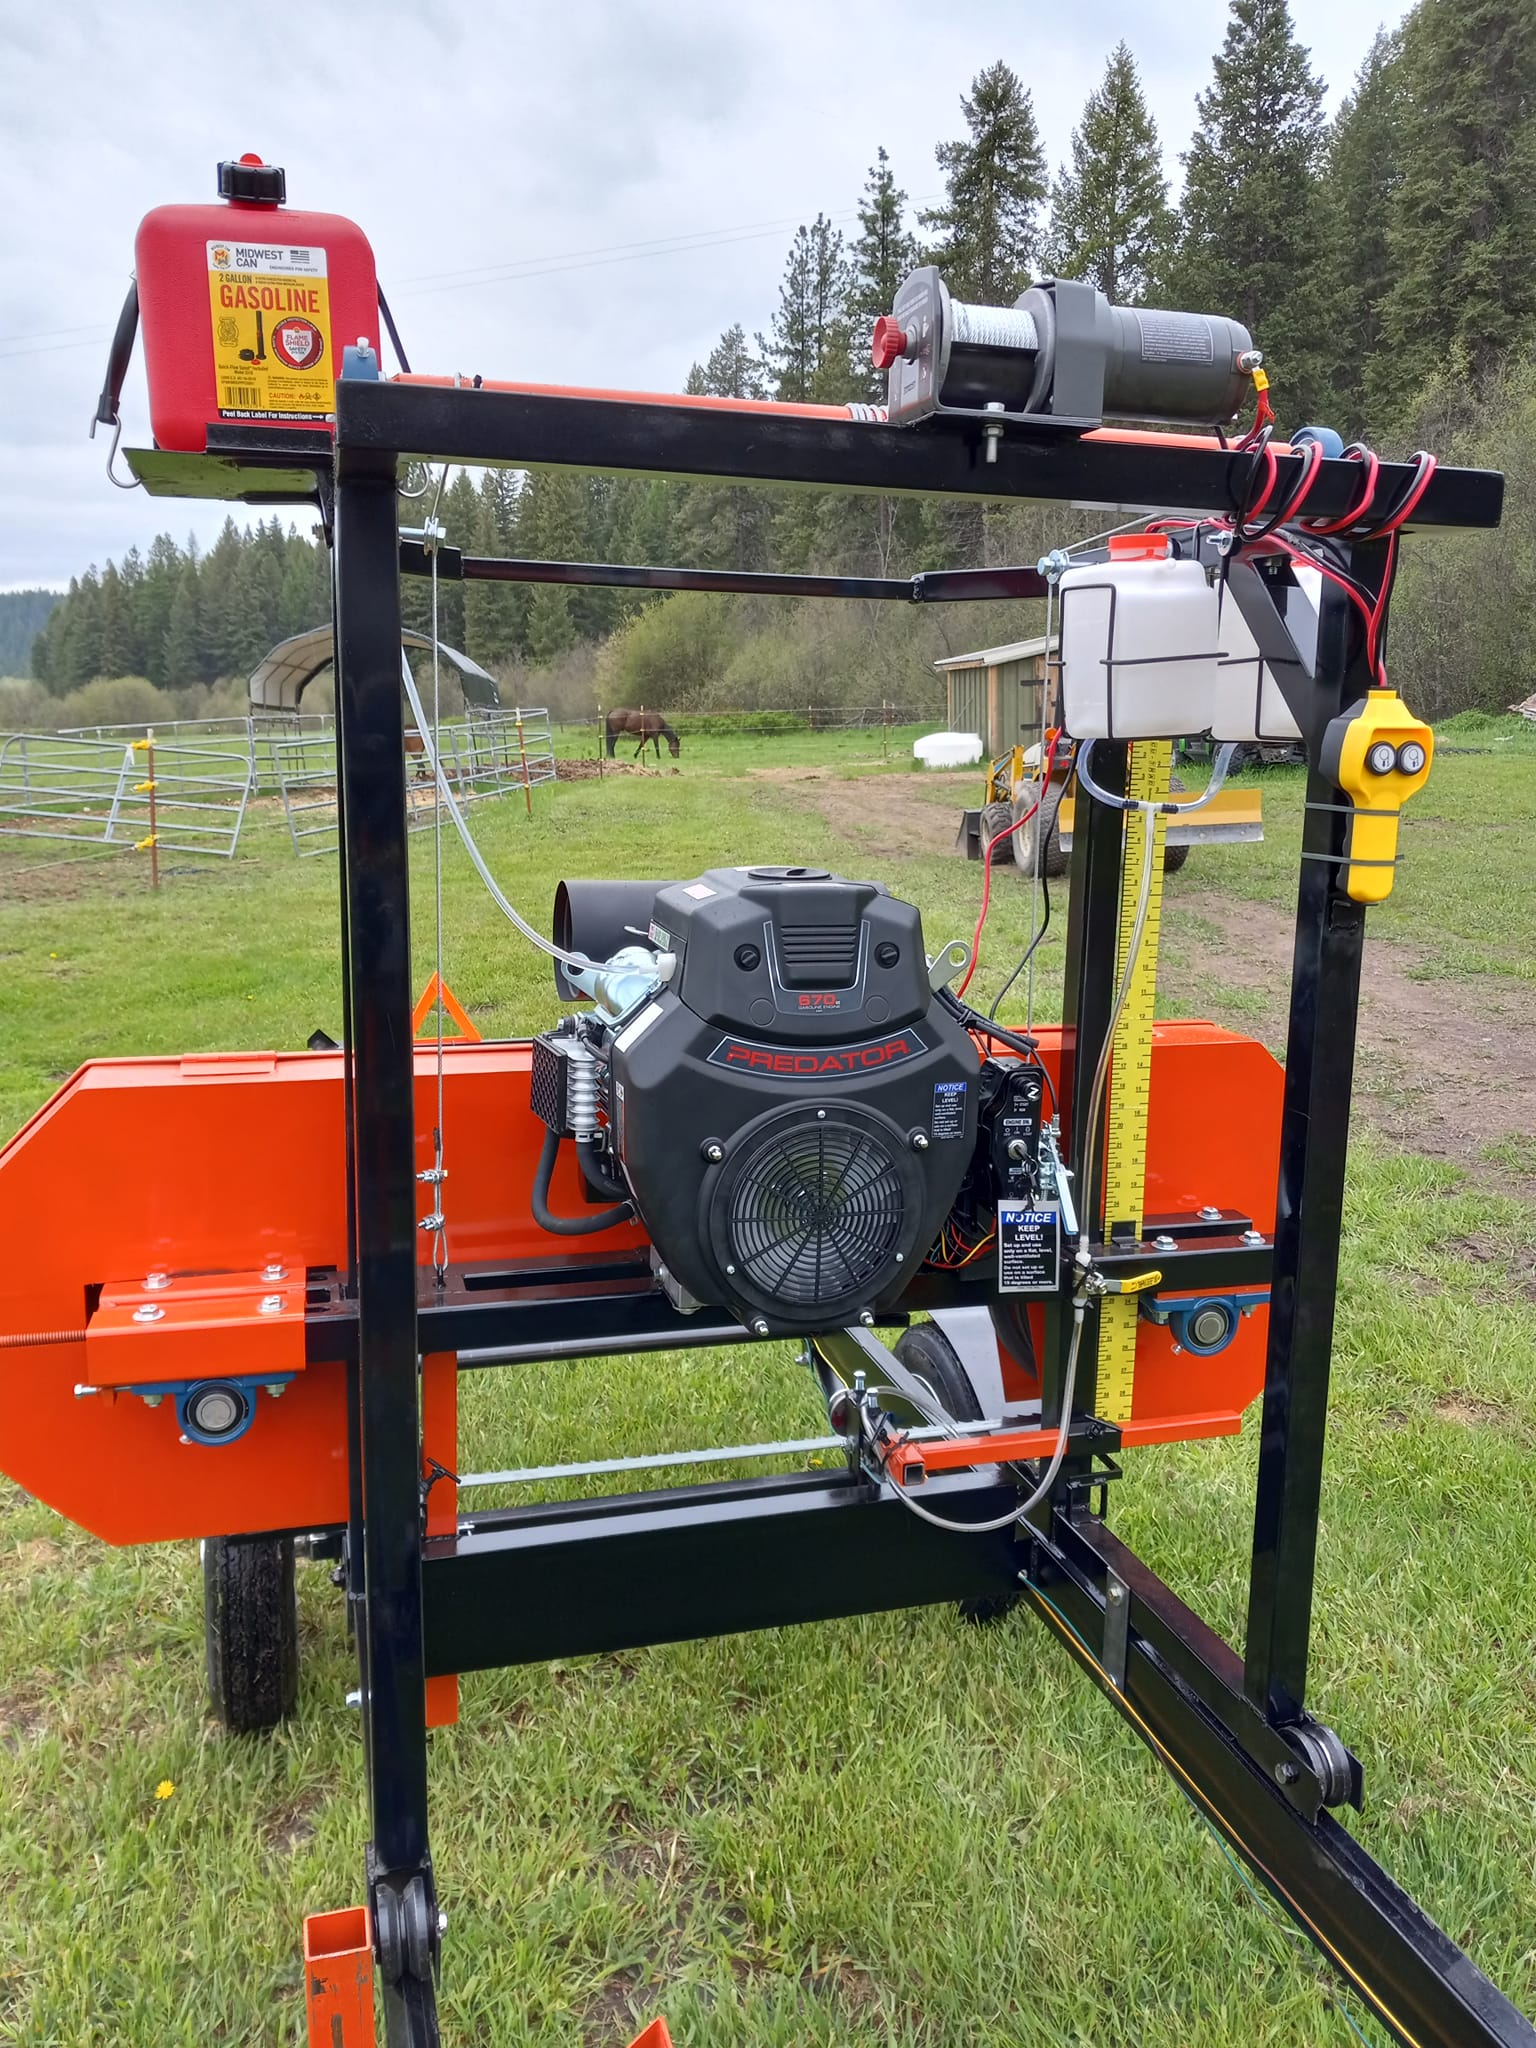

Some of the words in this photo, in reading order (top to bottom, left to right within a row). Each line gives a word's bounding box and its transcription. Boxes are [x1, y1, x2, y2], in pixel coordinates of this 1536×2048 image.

[236, 248, 283, 260] MIDWEST
[236, 258, 257, 268] CAN
[219, 273, 223, 282] 2
[225, 274, 252, 284] GALLON
[220, 284, 320, 313] GASOLINE
[236, 410, 250, 418] Back
[278, 412, 312, 420] Instructions
[799, 994, 836, 1006] 670
[726, 1040, 909, 1073] PREDATOR
[938, 1084, 963, 1092] NOTICE
[1006, 1213, 1052, 1222] NOTICE
